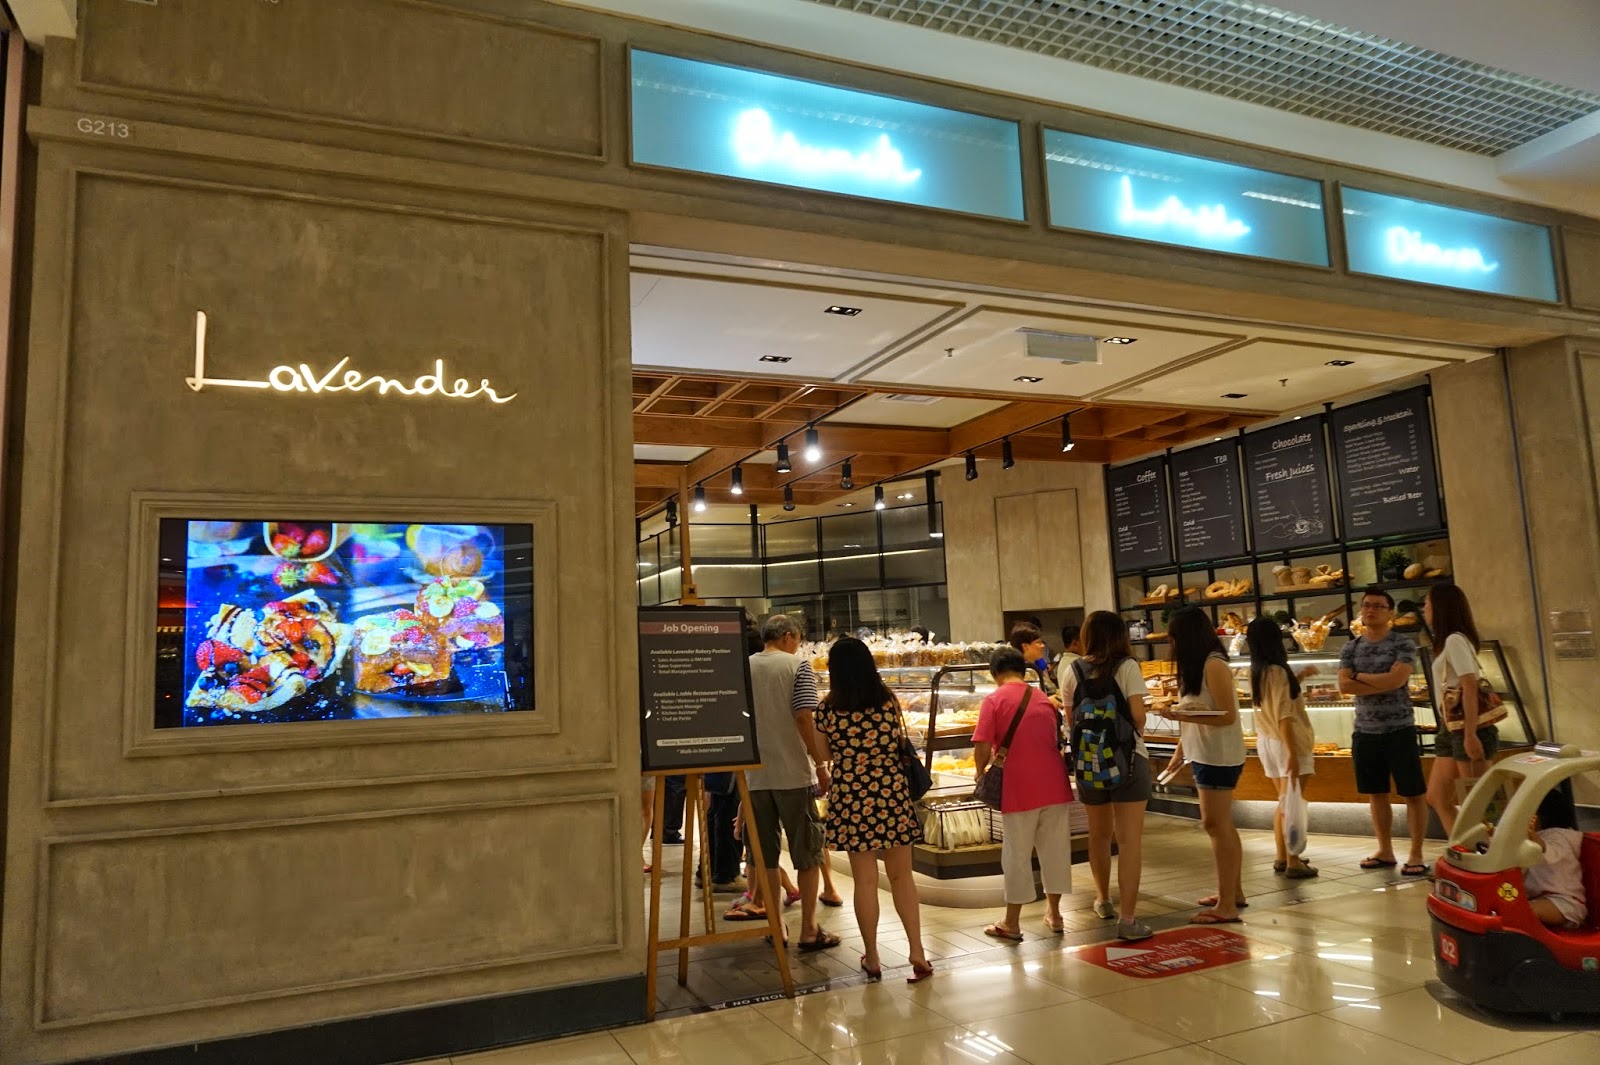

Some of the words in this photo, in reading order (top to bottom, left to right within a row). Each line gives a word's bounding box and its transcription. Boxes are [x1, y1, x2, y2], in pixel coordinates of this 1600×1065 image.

[77, 118, 129, 138] G213
[185, 310, 518, 404] Lavender
[1271, 433, 1312, 450] Chocolate
[1214, 454, 1228, 464] Tea
[1136, 469, 1157, 482] Coffee
[1265, 468, 1288, 482] Fresh
[1288, 462, 1315, 478] Juices
[662, 624, 679, 633] Job
[680, 623, 719, 634] Opening
[1441, 938, 1456, 959] 02
